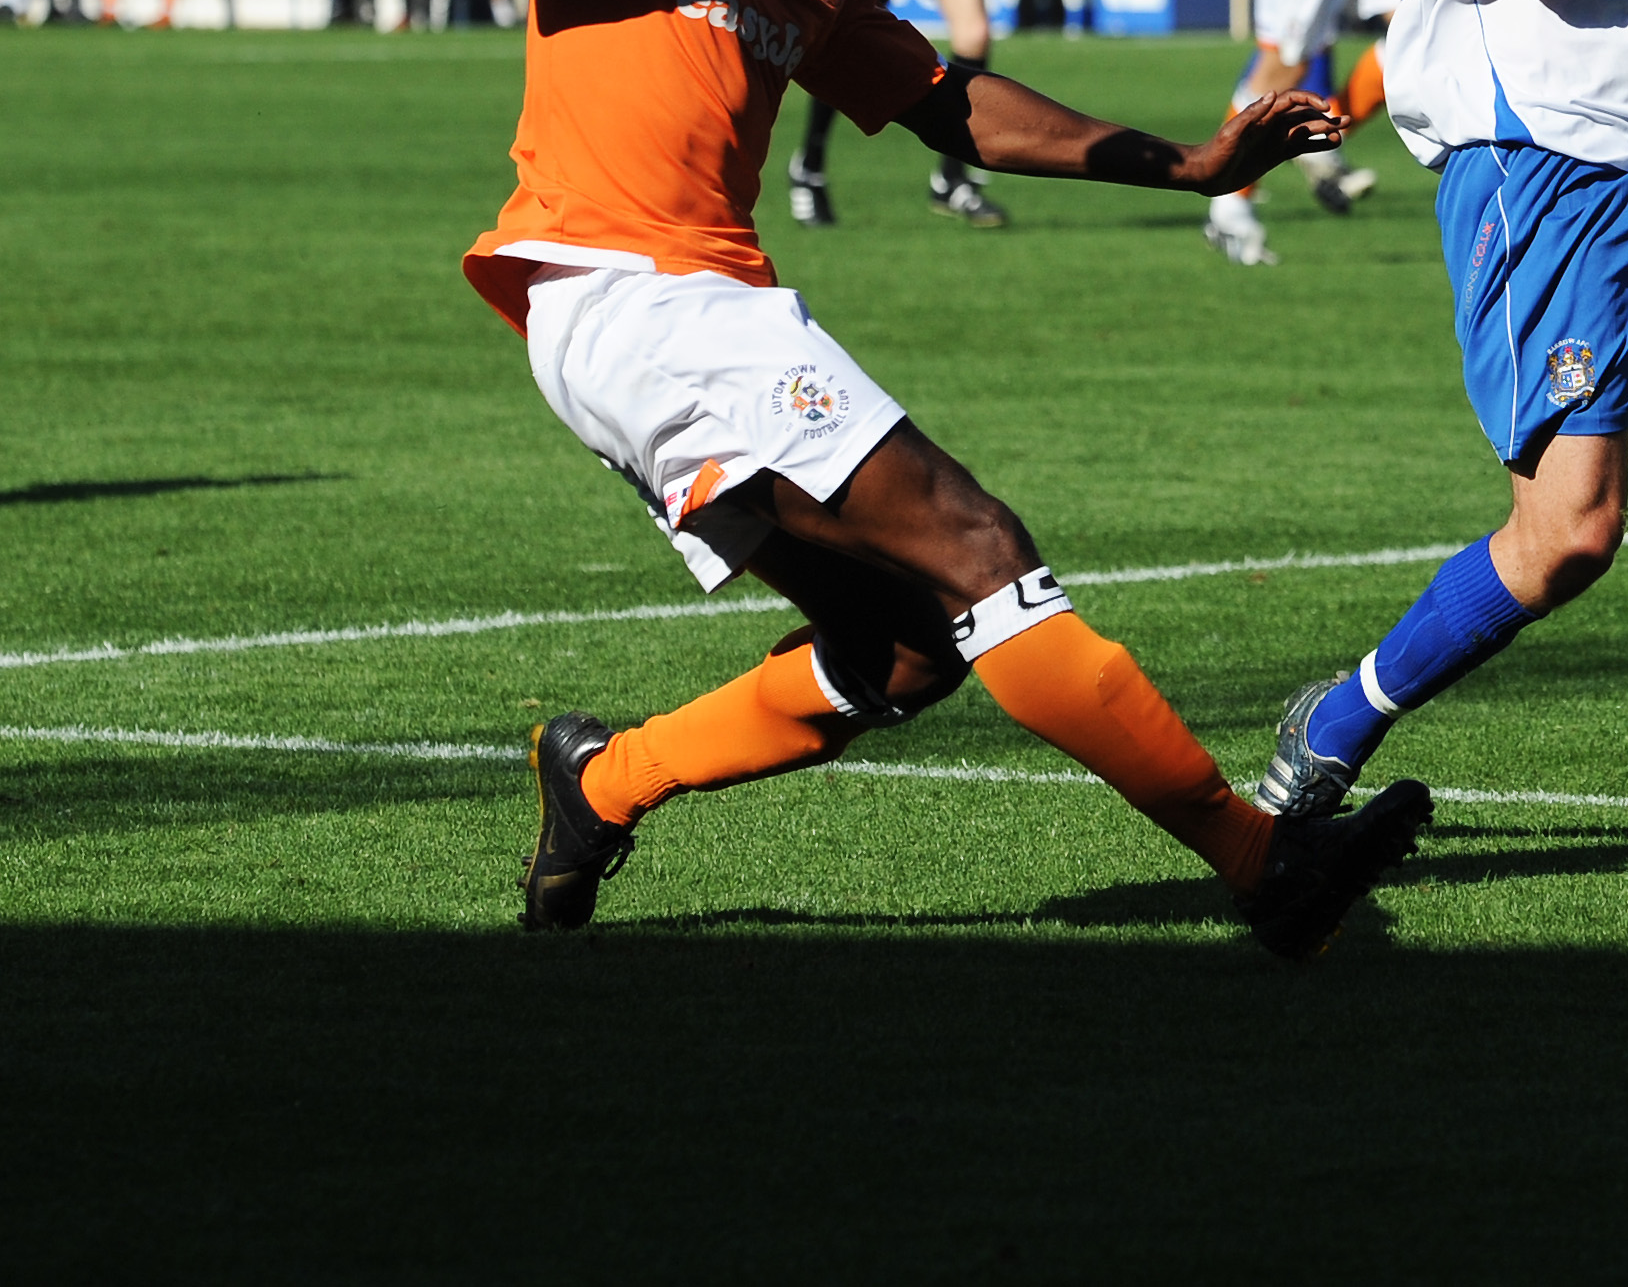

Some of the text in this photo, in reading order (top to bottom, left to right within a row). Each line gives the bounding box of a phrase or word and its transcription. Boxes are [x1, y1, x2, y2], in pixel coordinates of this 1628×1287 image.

[771, 364, 817, 415] LUTON TOWN
[803, 388, 850, 441] FOOTBALL CLUB
